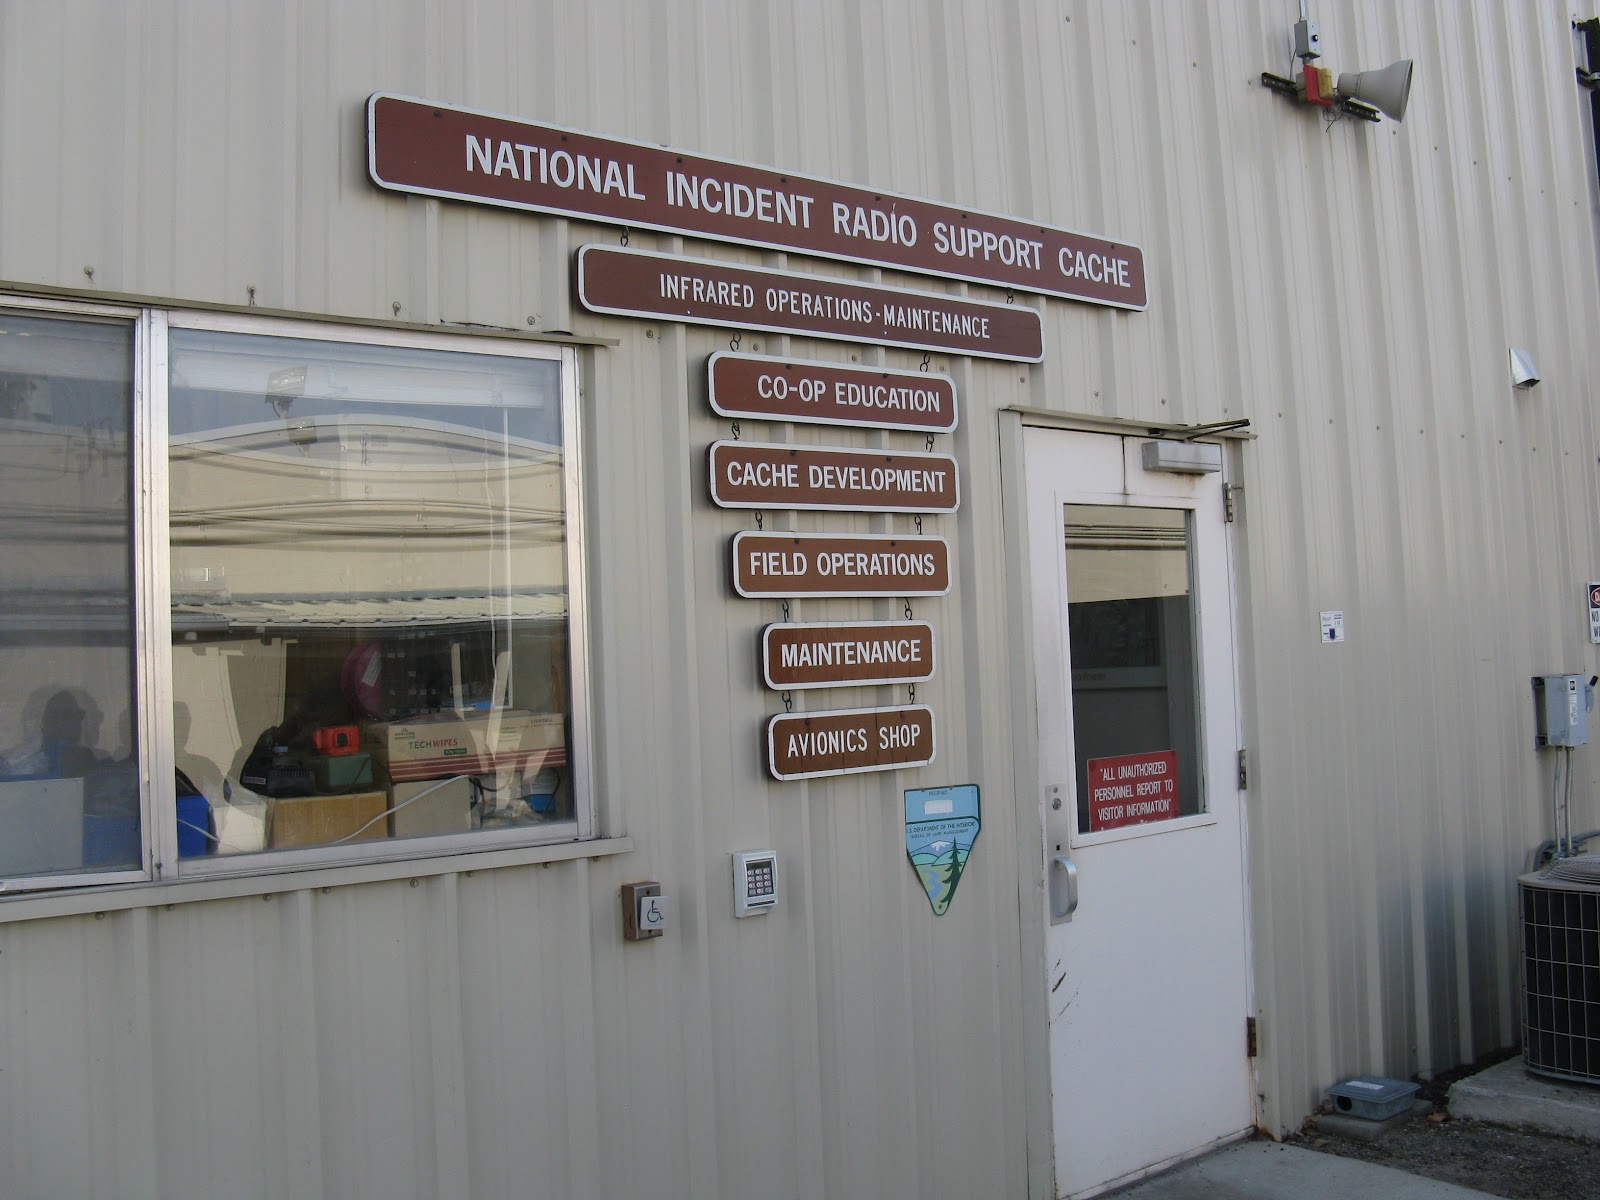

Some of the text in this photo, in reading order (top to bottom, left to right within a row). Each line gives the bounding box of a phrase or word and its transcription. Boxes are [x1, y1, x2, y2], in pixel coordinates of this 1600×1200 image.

[465, 133, 1131, 288] NATIONAL INCIDENT RADIO SUPPORT CACHE
[660, 273, 755, 308] INFRARED
[757, 374, 941, 413] CO-OP EDUCATION
[727, 461, 946, 493] CACHE DEVELOPMENT
[750, 552, 936, 576] FIELD OPERATIONS
[781, 639, 922, 668] MAINTENANCE
[408, 738, 458, 750] TECHWIPES
[787, 723, 921, 758] AVIONICS SHOP
[1118, 761, 1167, 780] UNAUTHORIZED
[1094, 779, 1173, 802] PERSONNEL REPORT TO
[1098, 805, 1124, 821] VISITOR
